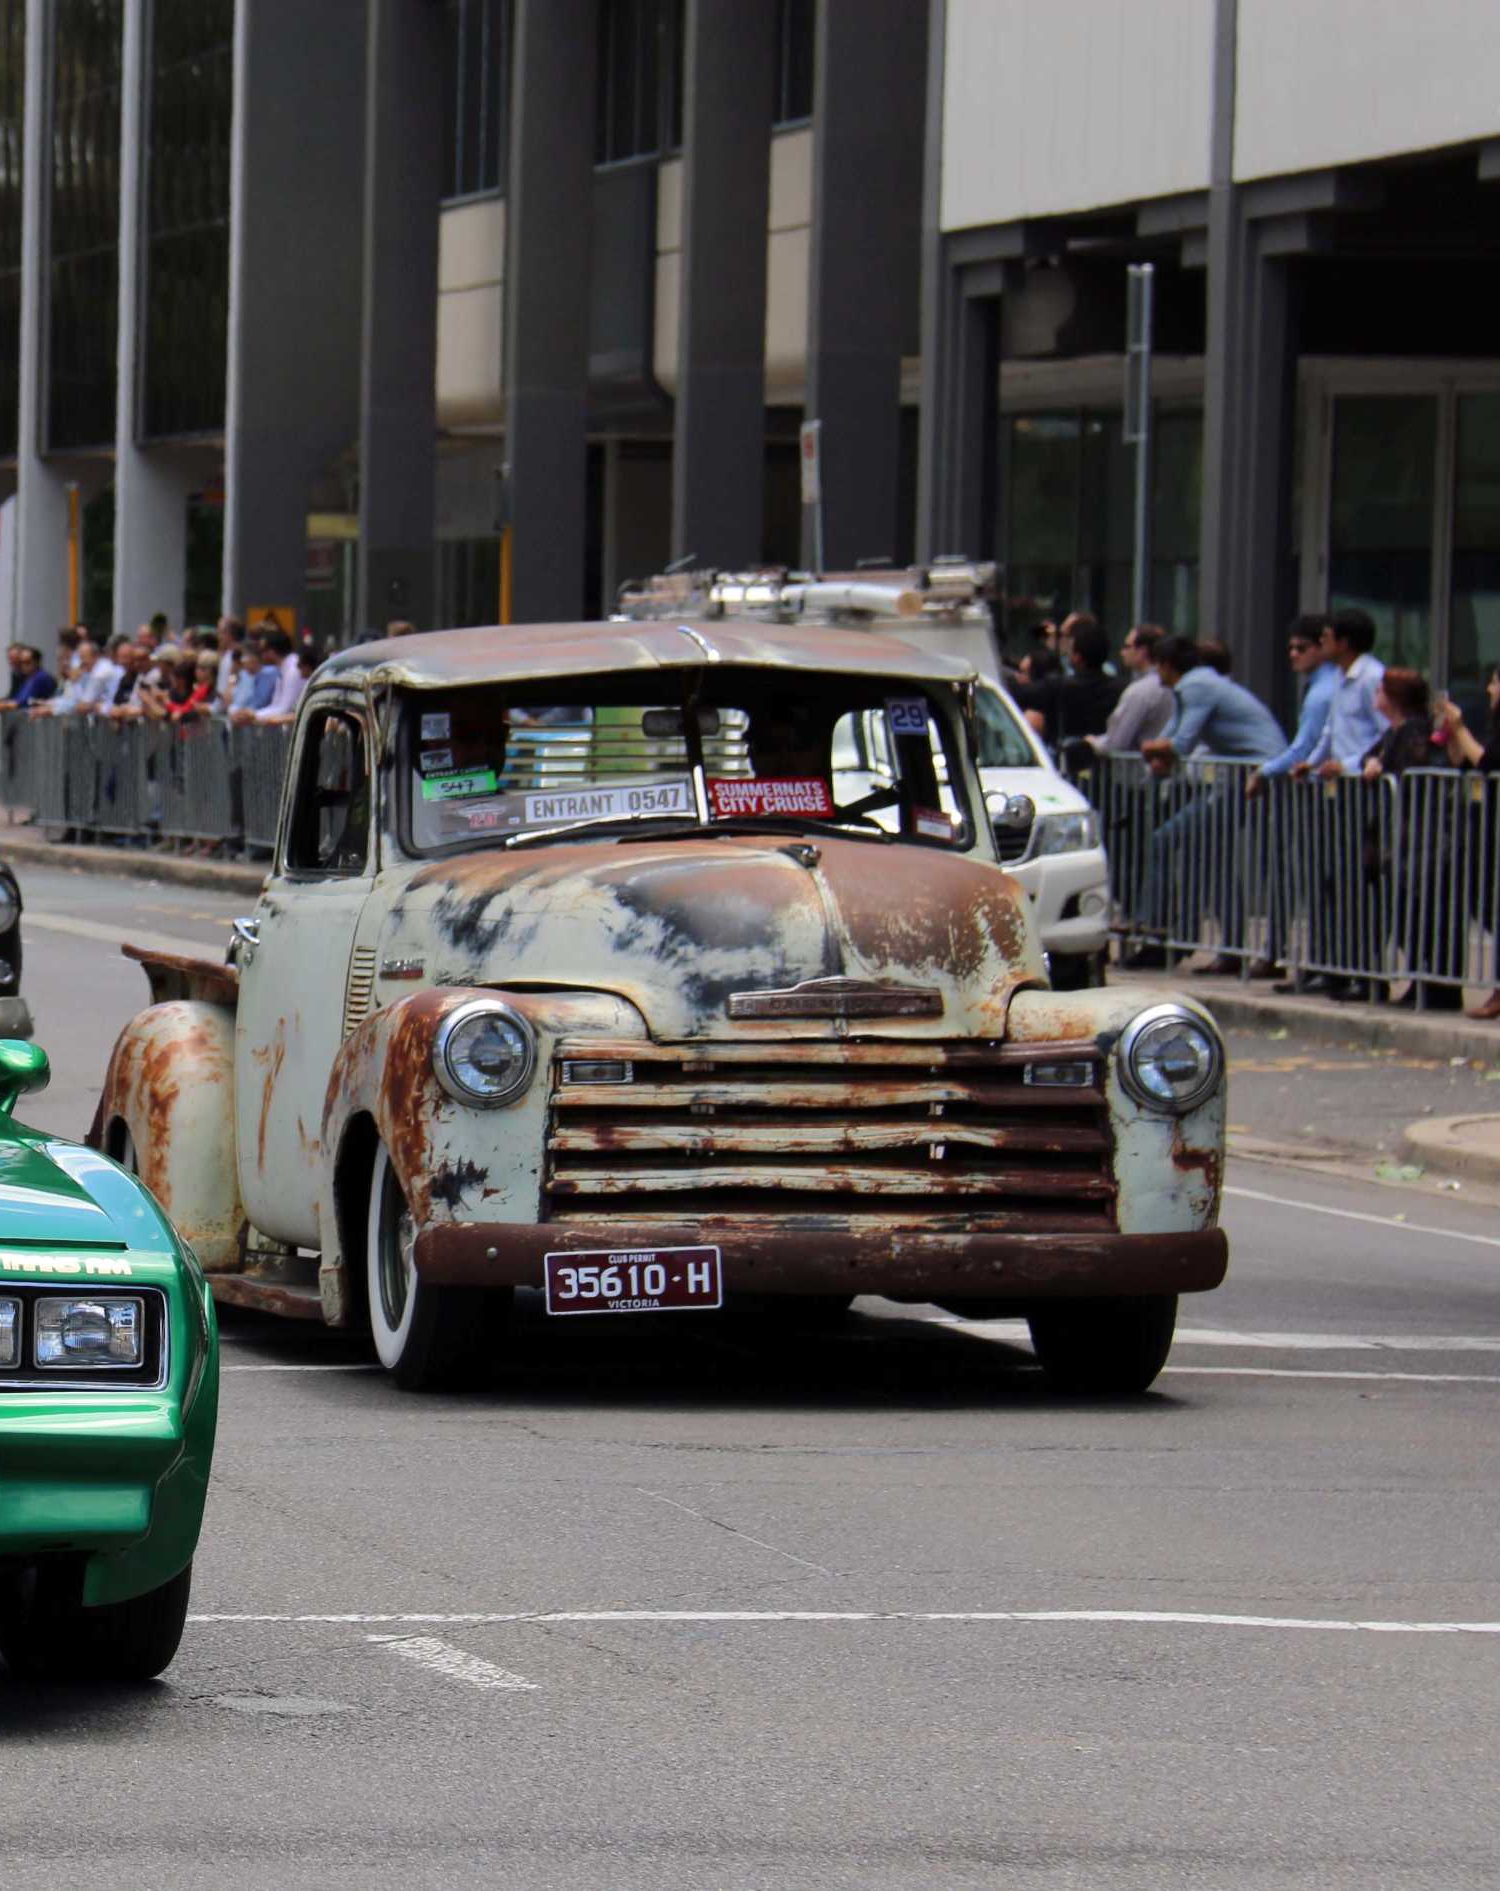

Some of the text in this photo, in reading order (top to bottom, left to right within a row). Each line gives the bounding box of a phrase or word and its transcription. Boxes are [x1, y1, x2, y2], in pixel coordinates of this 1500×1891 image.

[891, 704, 924, 727] 29
[714, 780, 824, 798] SUMMERNATS
[532, 794, 614, 818] ENTRANT
[628, 788, 680, 810] 0547
[718, 797, 828, 812] CITY CRUISE
[86, 1258, 133, 1276] AM
[608, 1254, 656, 1264] CLUB PERMIT
[608, 1299, 660, 1310] VICTORIA
